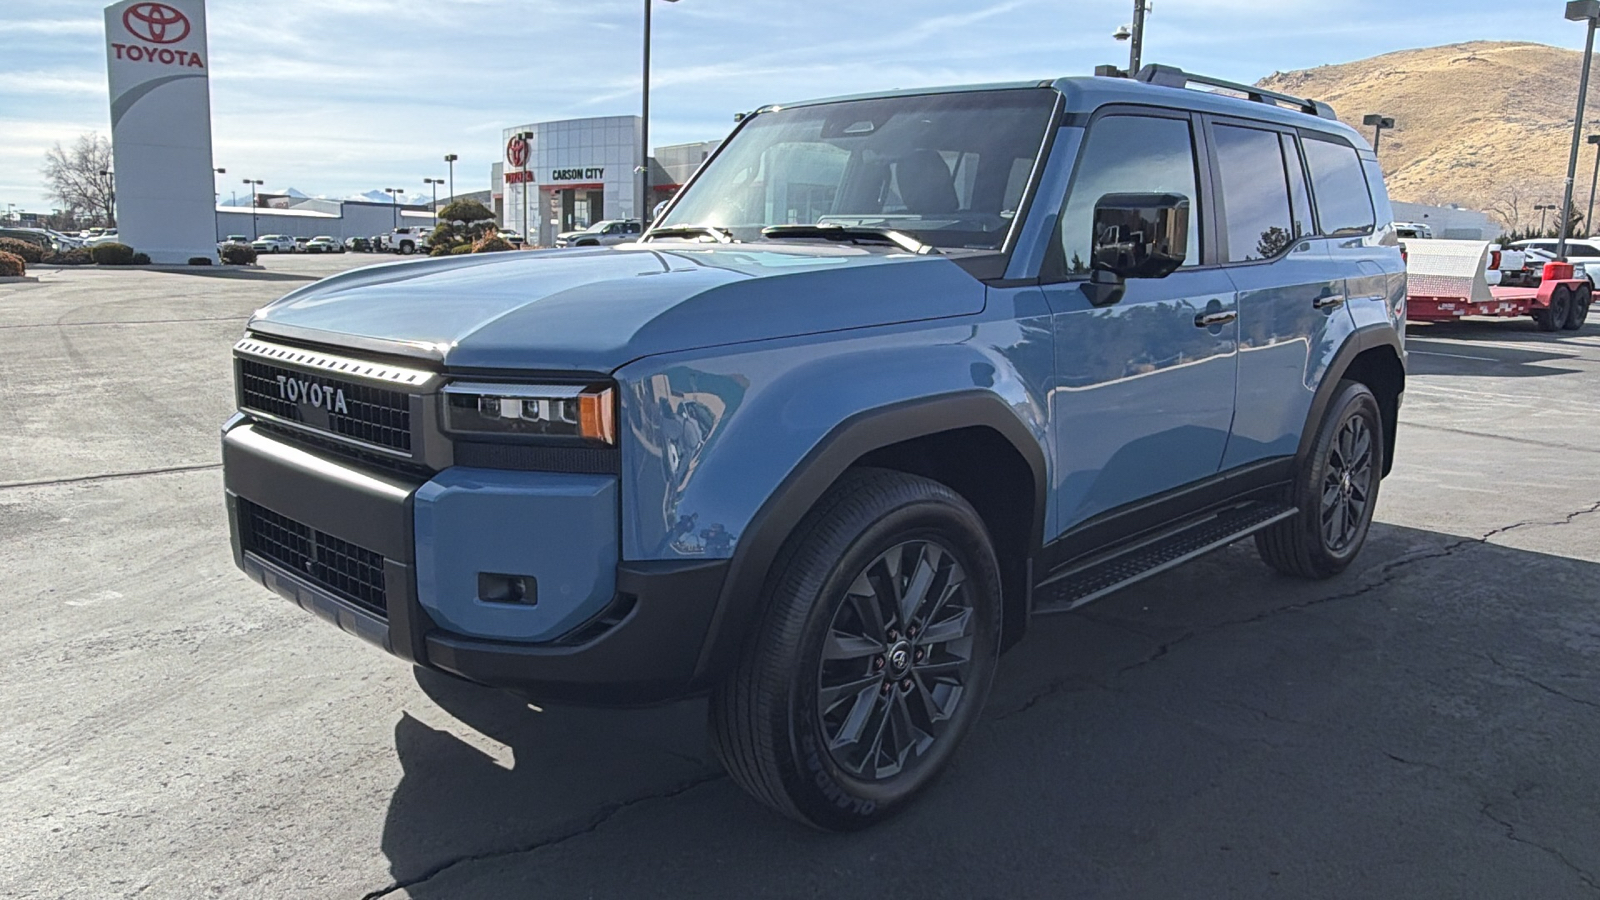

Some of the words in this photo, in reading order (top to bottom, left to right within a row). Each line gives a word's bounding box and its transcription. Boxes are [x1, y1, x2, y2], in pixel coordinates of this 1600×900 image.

[111, 43, 204, 68] TOYOTA
[552, 169, 584, 180] CARSON
[585, 168, 604, 179] CITY
[276, 375, 348, 414] TOYOTA
